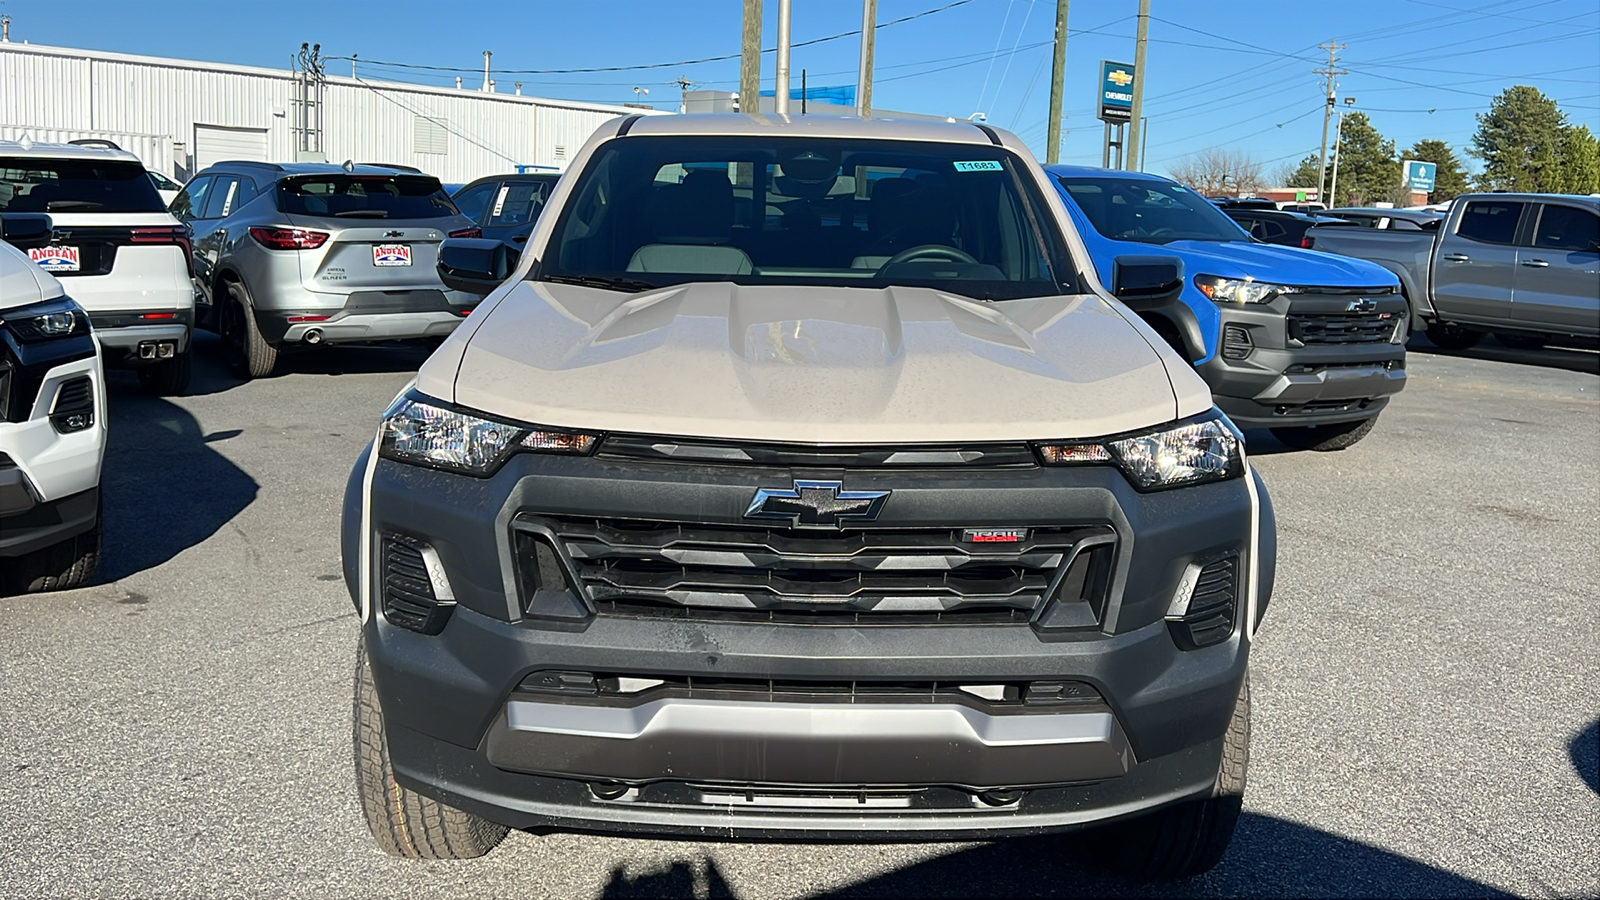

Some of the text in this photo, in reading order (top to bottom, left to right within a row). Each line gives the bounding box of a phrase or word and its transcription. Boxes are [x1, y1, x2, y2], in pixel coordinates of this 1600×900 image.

[1105, 91, 1133, 102] CHEVROLET
[959, 162, 996, 170] T1683
[32, 249, 77, 262] ANDEAN
[375, 248, 409, 259] ANDEAN
[966, 529, 1025, 537] TRAIL
